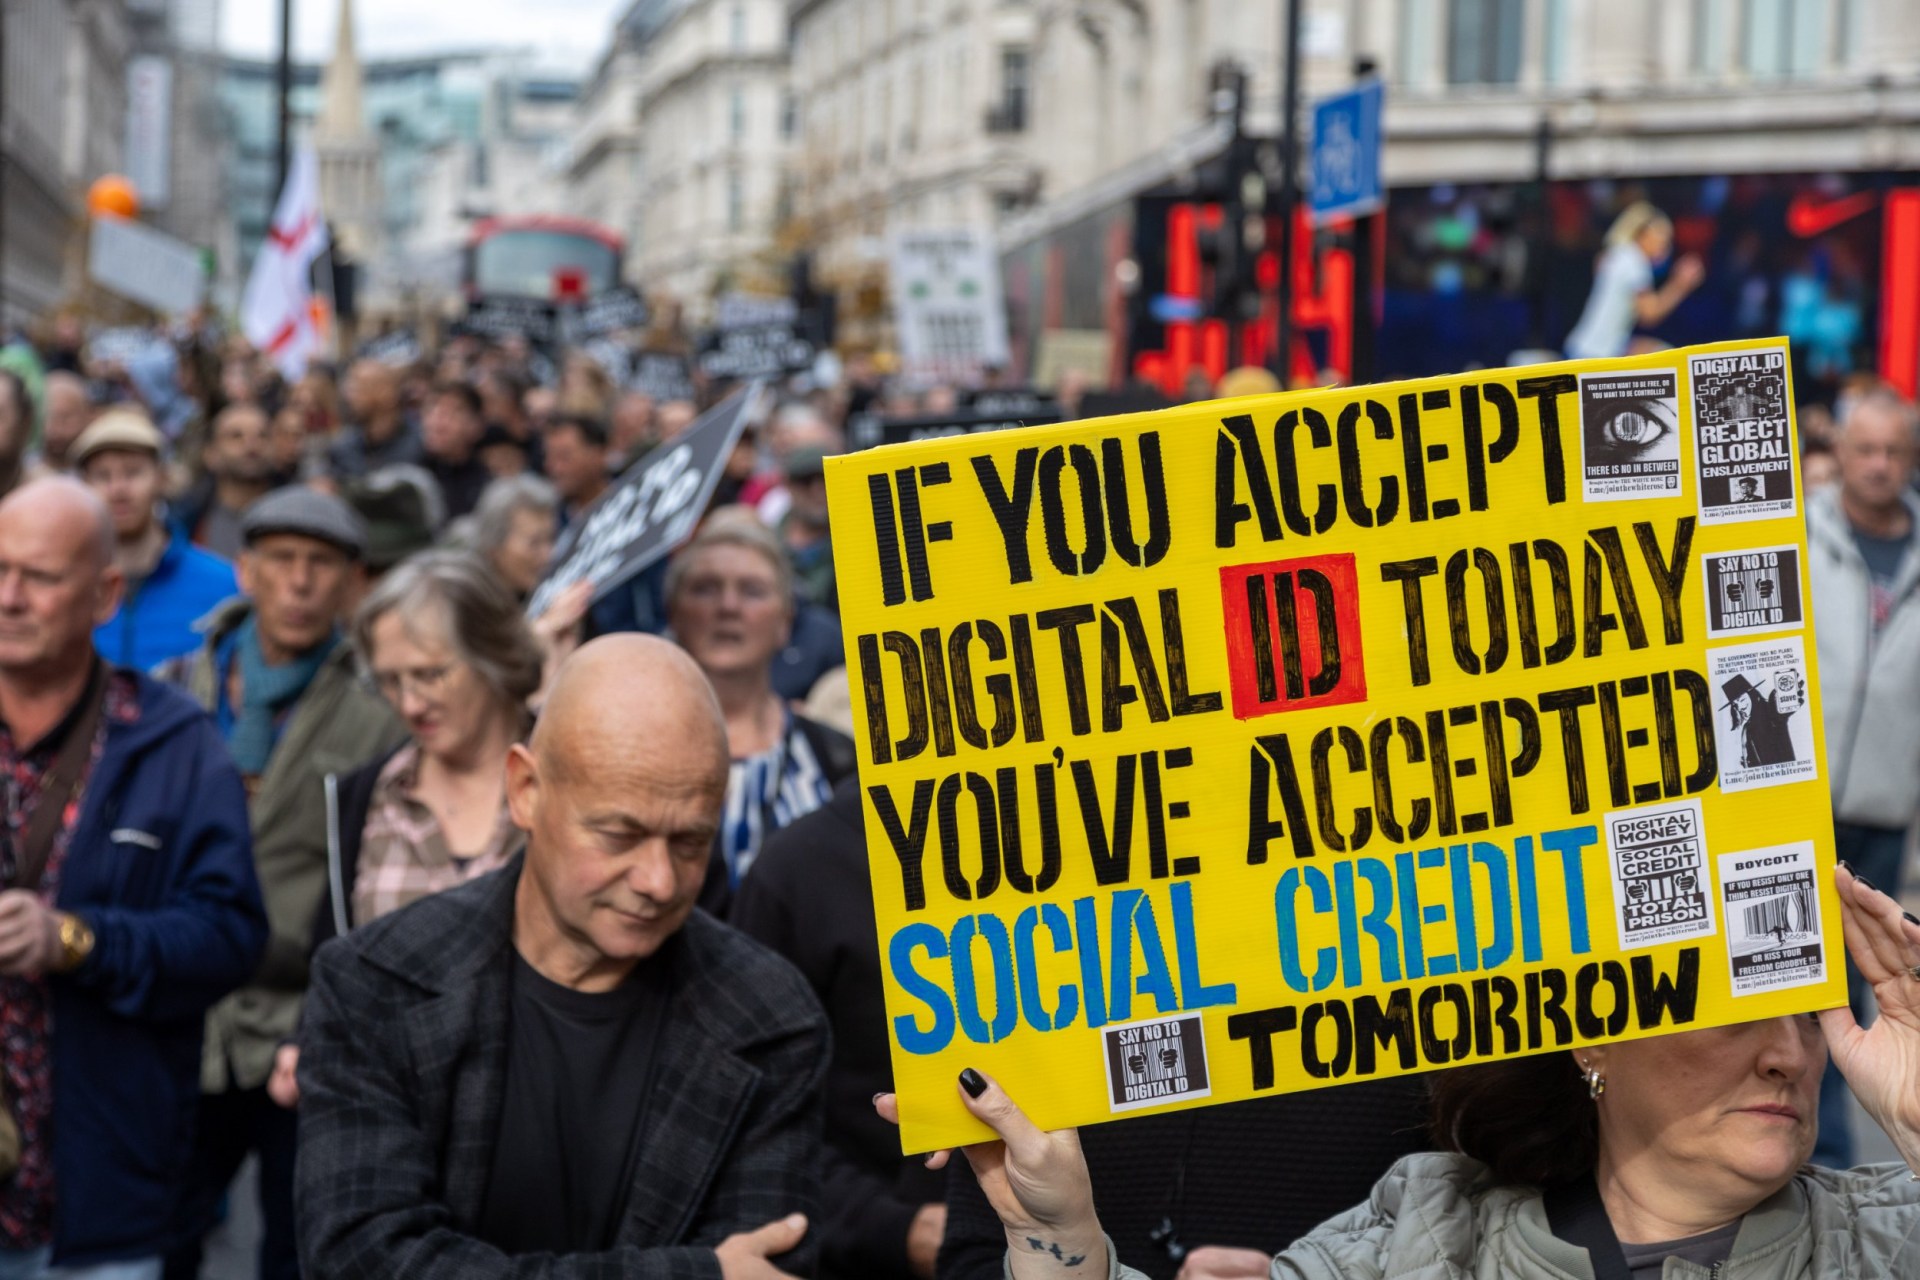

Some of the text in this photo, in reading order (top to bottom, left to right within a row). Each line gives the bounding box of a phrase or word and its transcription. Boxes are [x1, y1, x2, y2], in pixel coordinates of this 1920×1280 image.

[1694, 354, 1783, 376] DIGITAL ID
[1634, 388, 1666, 397] CONTROLLED
[1700, 419, 1786, 444] REJECT
[1702, 440, 1789, 464] GLOBAL
[1587, 461, 1677, 476] THERE IS NO IN BETWEEN
[1702, 460, 1789, 478] ENSLAVEMENT
[867, 461, 954, 607] IF
[970, 431, 1171, 585] YOU
[1214, 374, 1578, 549] ACCEPT
[1589, 483, 1664, 494] t.me/jointhewhiterose
[1718, 553, 1778, 573] SAY NO TO
[1722, 608, 1783, 629] DIGITAL ID
[857, 515, 1697, 765] DIGITAL ID TODAY
[1728, 652, 1758, 661] GOVERNMENT
[1725, 766, 1812, 785] t.me/jointhewhiterose
[866, 668, 1719, 912] YOU'VE ACCEPTED
[1618, 814, 1690, 833] DIGITAL
[1619, 823, 1691, 844] MONEY
[1622, 843, 1694, 863] SOCIAL
[1735, 853, 1799, 871] BOYCOTT
[1623, 853, 1695, 876] CREDIT
[1728, 871, 1809, 891] IF YOU RESIST ONLY ONE
[1728, 891, 1749, 902] THING
[1750, 887, 1774, 898] RESIST
[1775, 883, 1800, 894] DIGITAL
[1627, 895, 1702, 917] TOTAL
[1628, 907, 1703, 930] PRISON
[888, 824, 1599, 1055] SOCIAL CREDIT
[1752, 948, 1802, 963] OR KISS YOUR
[1739, 963, 1774, 976] FREEDOM
[1775, 957, 1808, 970] GOODBYE
[1227, 947, 1701, 1092] TOMORROW
[1118, 1021, 1181, 1045] SAY NO TO
[1125, 1077, 1189, 1101] DIGITAL ID
